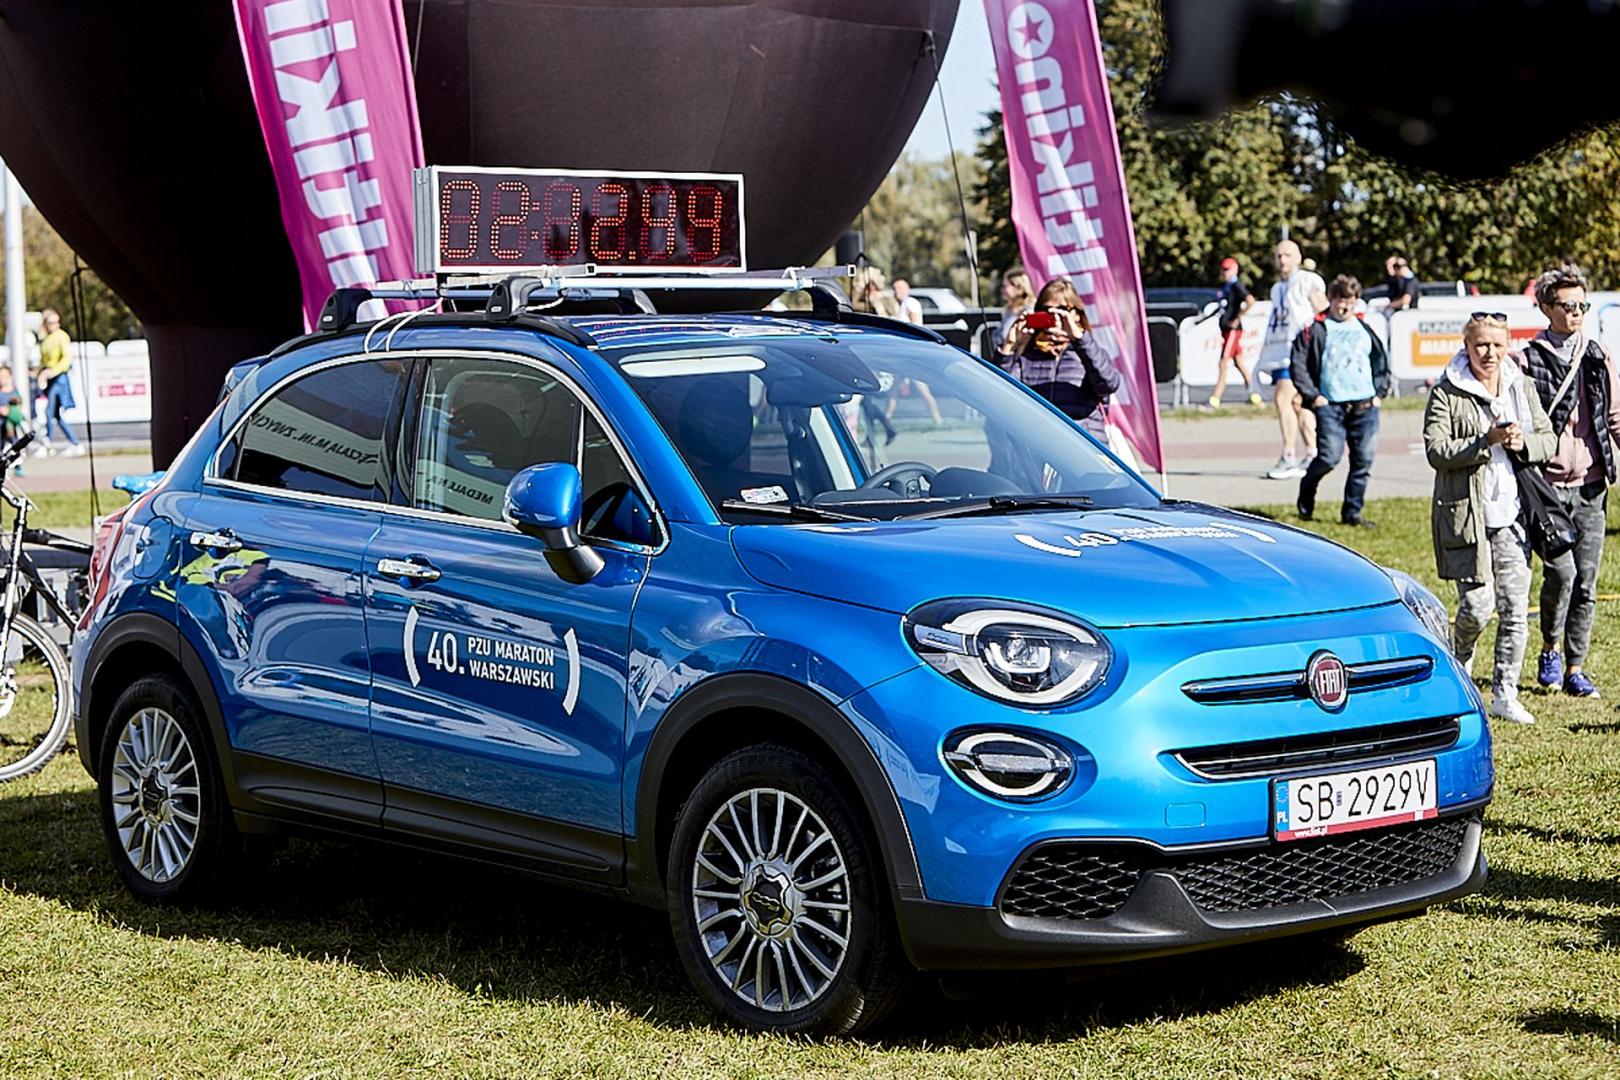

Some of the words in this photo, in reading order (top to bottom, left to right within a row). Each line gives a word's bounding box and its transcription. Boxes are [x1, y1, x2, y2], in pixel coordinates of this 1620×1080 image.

[427, 631, 465, 675] 40.
[468, 636, 491, 656] PZU
[495, 641, 554, 666] MARATON
[469, 660, 554, 690] WARSZAWSKI
[1319, 669, 1341, 694] FIAT
[1297, 781, 1335, 823] SB
[1347, 767, 1430, 818] 2929V
[1276, 812, 1289, 824] PL
